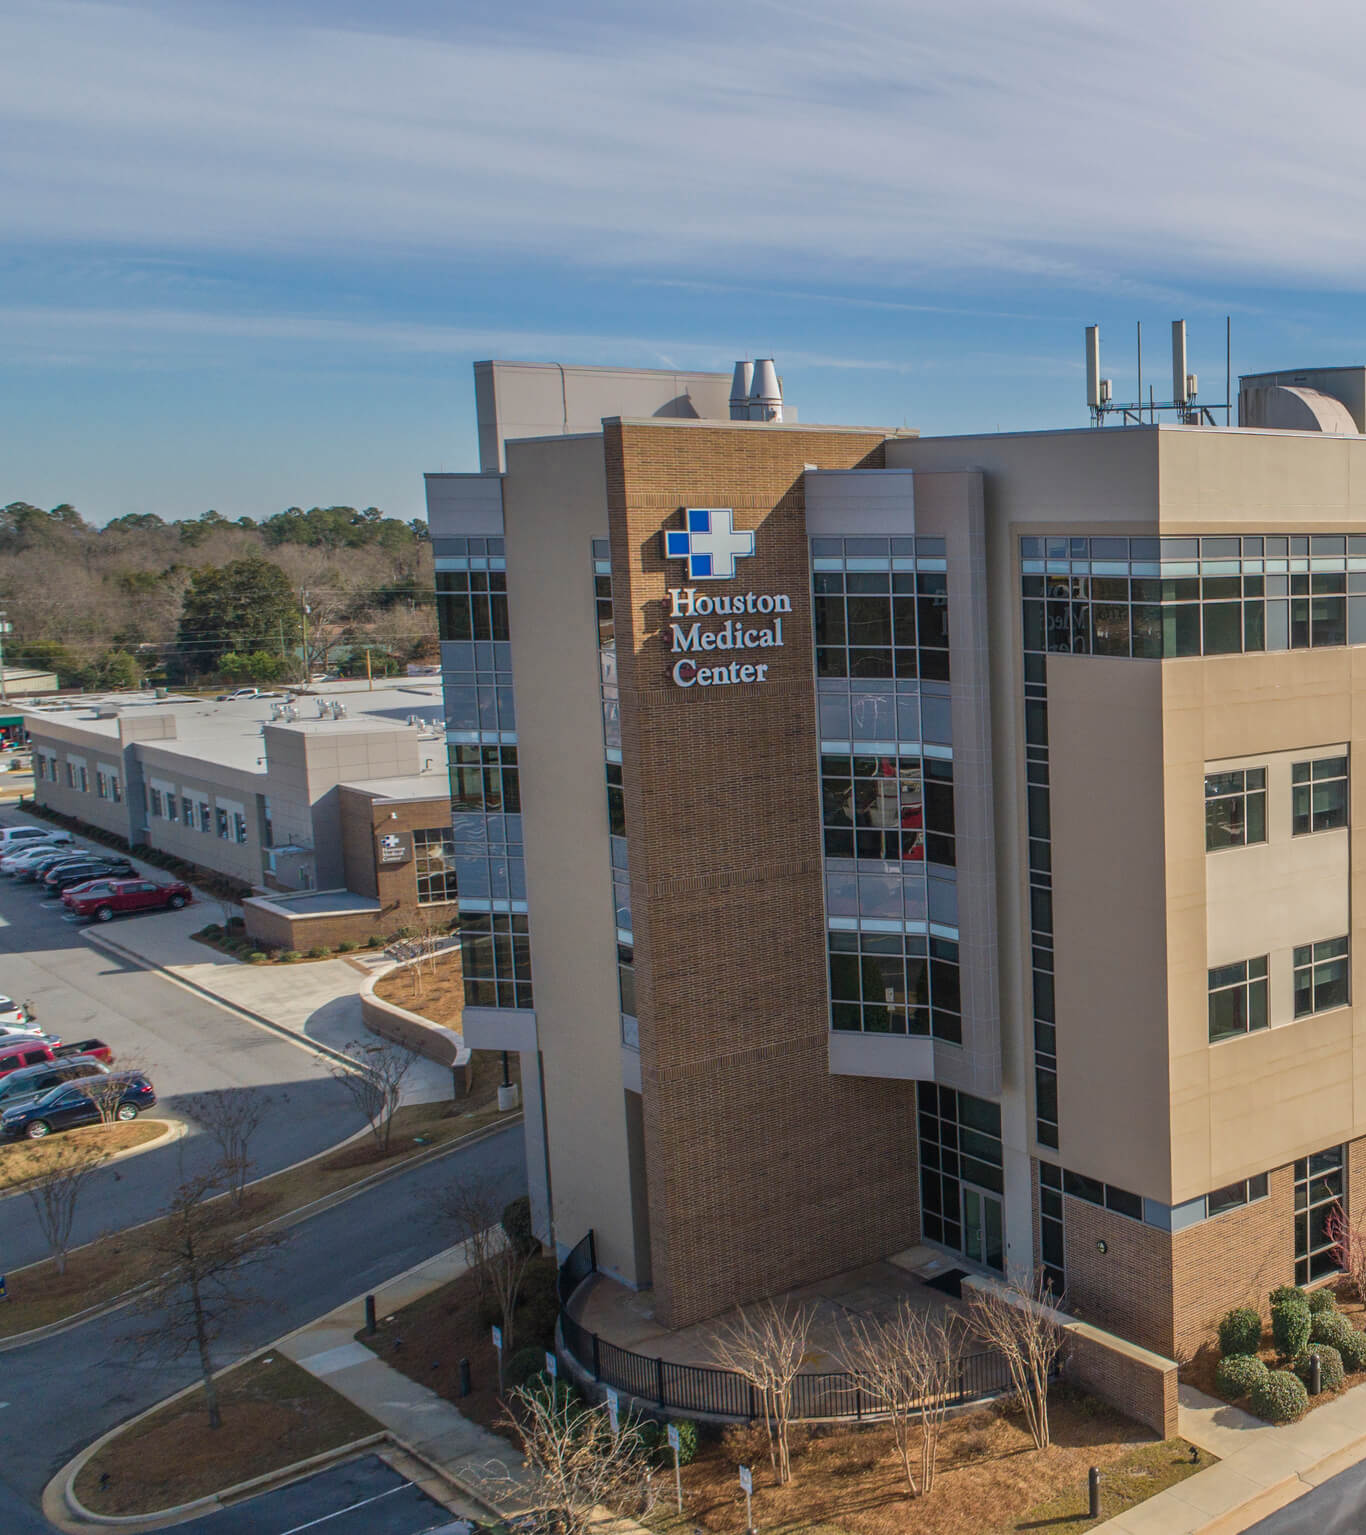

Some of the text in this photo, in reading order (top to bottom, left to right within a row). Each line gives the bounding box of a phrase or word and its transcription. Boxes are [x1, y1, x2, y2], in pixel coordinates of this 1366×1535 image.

[669, 588, 792, 617] Houston
[670, 619, 784, 652] Medical
[674, 659, 768, 687] Center
